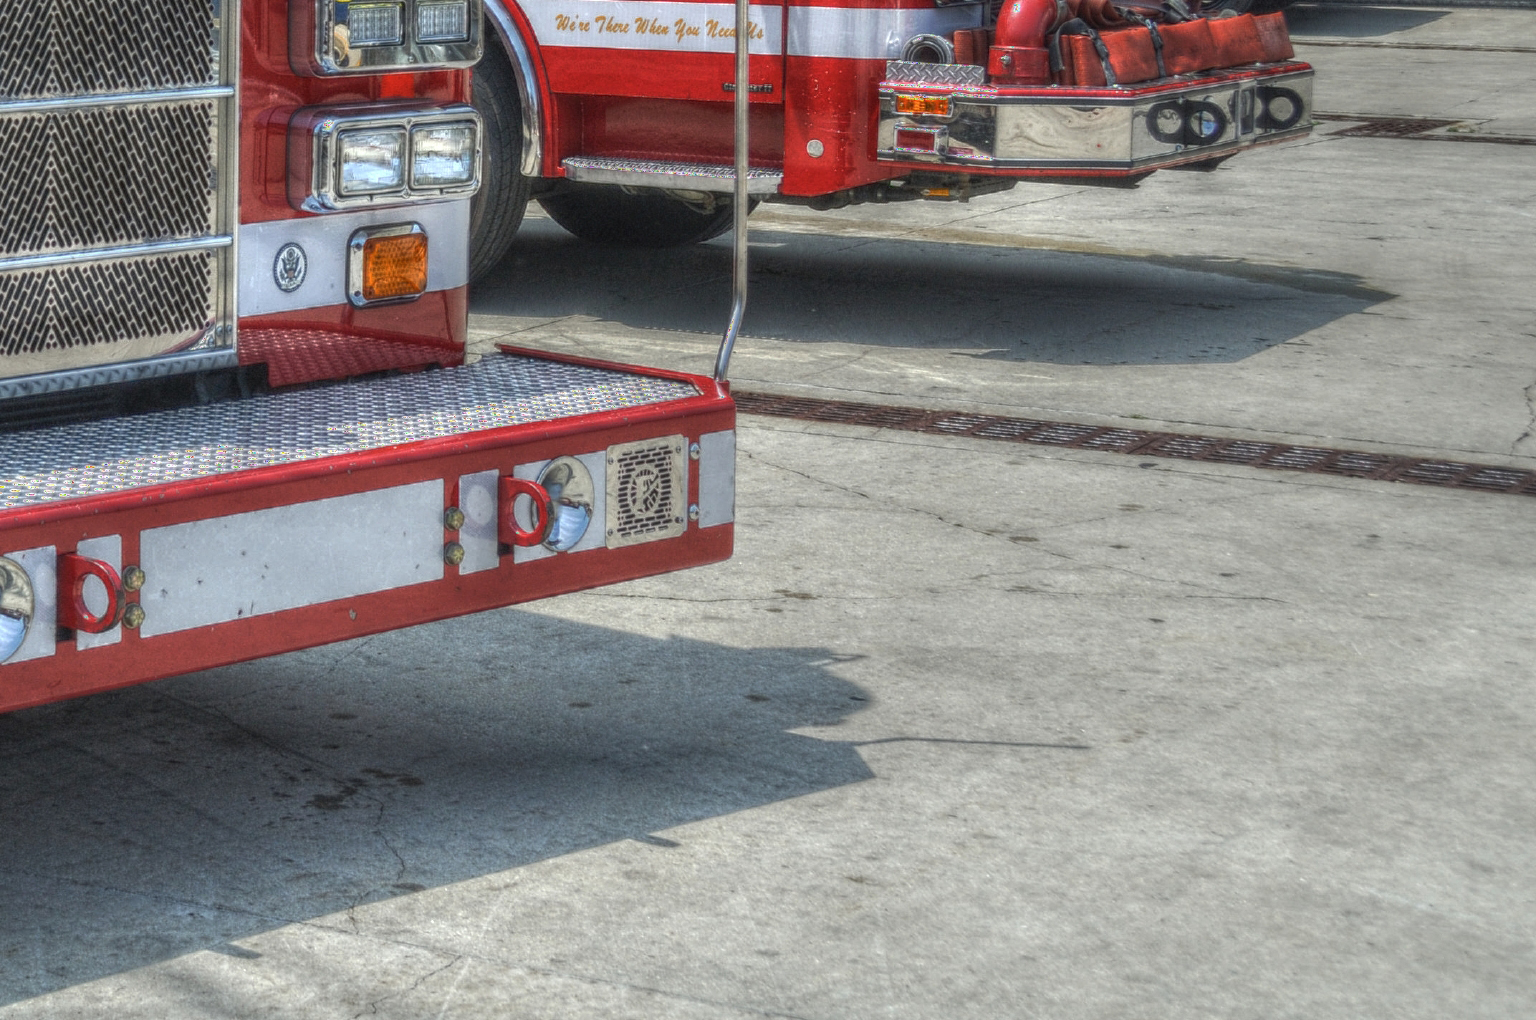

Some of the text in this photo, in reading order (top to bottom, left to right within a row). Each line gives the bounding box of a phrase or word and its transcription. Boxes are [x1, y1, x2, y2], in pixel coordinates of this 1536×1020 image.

[555, 14, 590, 31] We're
[595, 15, 630, 34] There
[635, 17, 669, 35] When
[674, 18, 700, 44] You
